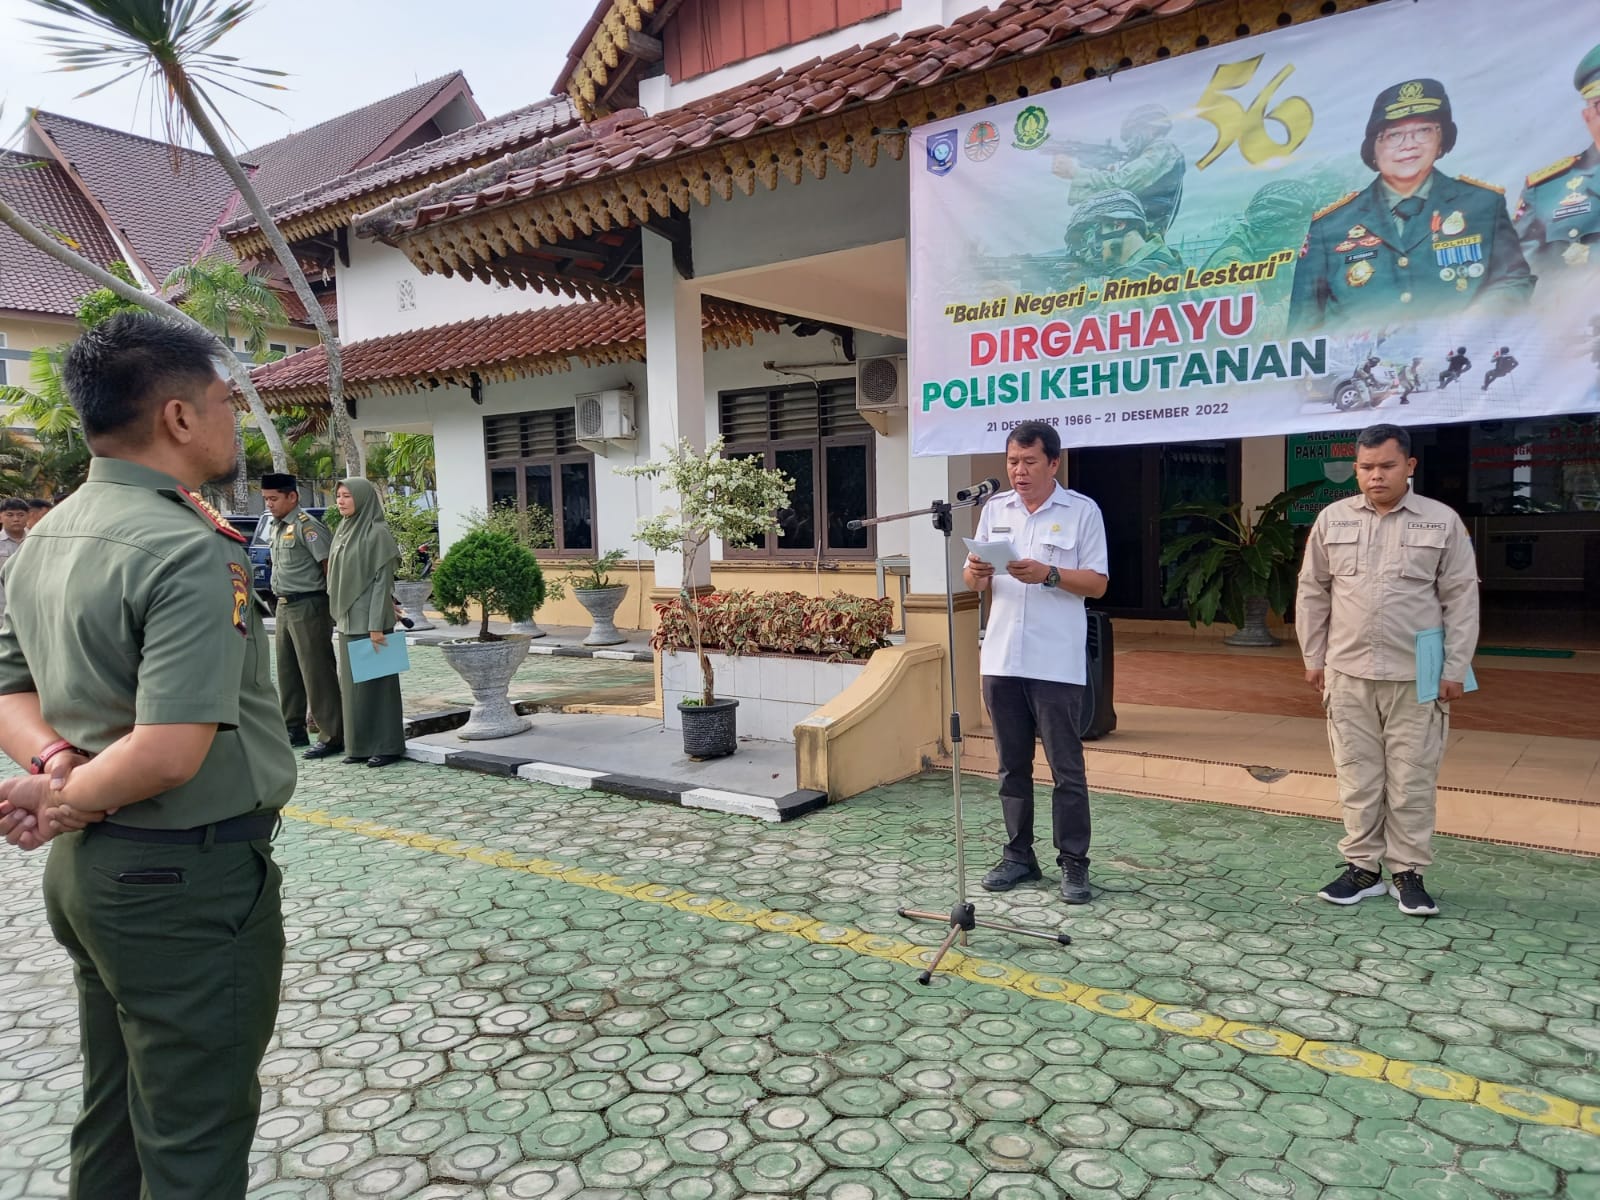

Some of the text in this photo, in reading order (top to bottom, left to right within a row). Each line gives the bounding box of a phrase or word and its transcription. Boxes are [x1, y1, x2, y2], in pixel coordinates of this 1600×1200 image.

[1195, 53, 1314, 171] 56
[1433, 236, 1478, 249] POLHUT
[1014, 286, 1085, 315] Negeri
[1103, 276, 1178, 302] Rimba
[970, 295, 1254, 367] DIRGAHAYU
[922, 338, 1327, 412] POLISI KEHUTANAN
[987, 422, 997, 432] 21
[1065, 415, 1092, 426] 1966
[1104, 412, 1116, 423] 21
[1122, 406, 1189, 422] DESEMBER
[1195, 402, 1229, 416] 2022
[1295, 442, 1356, 459] PAKAI MAS
